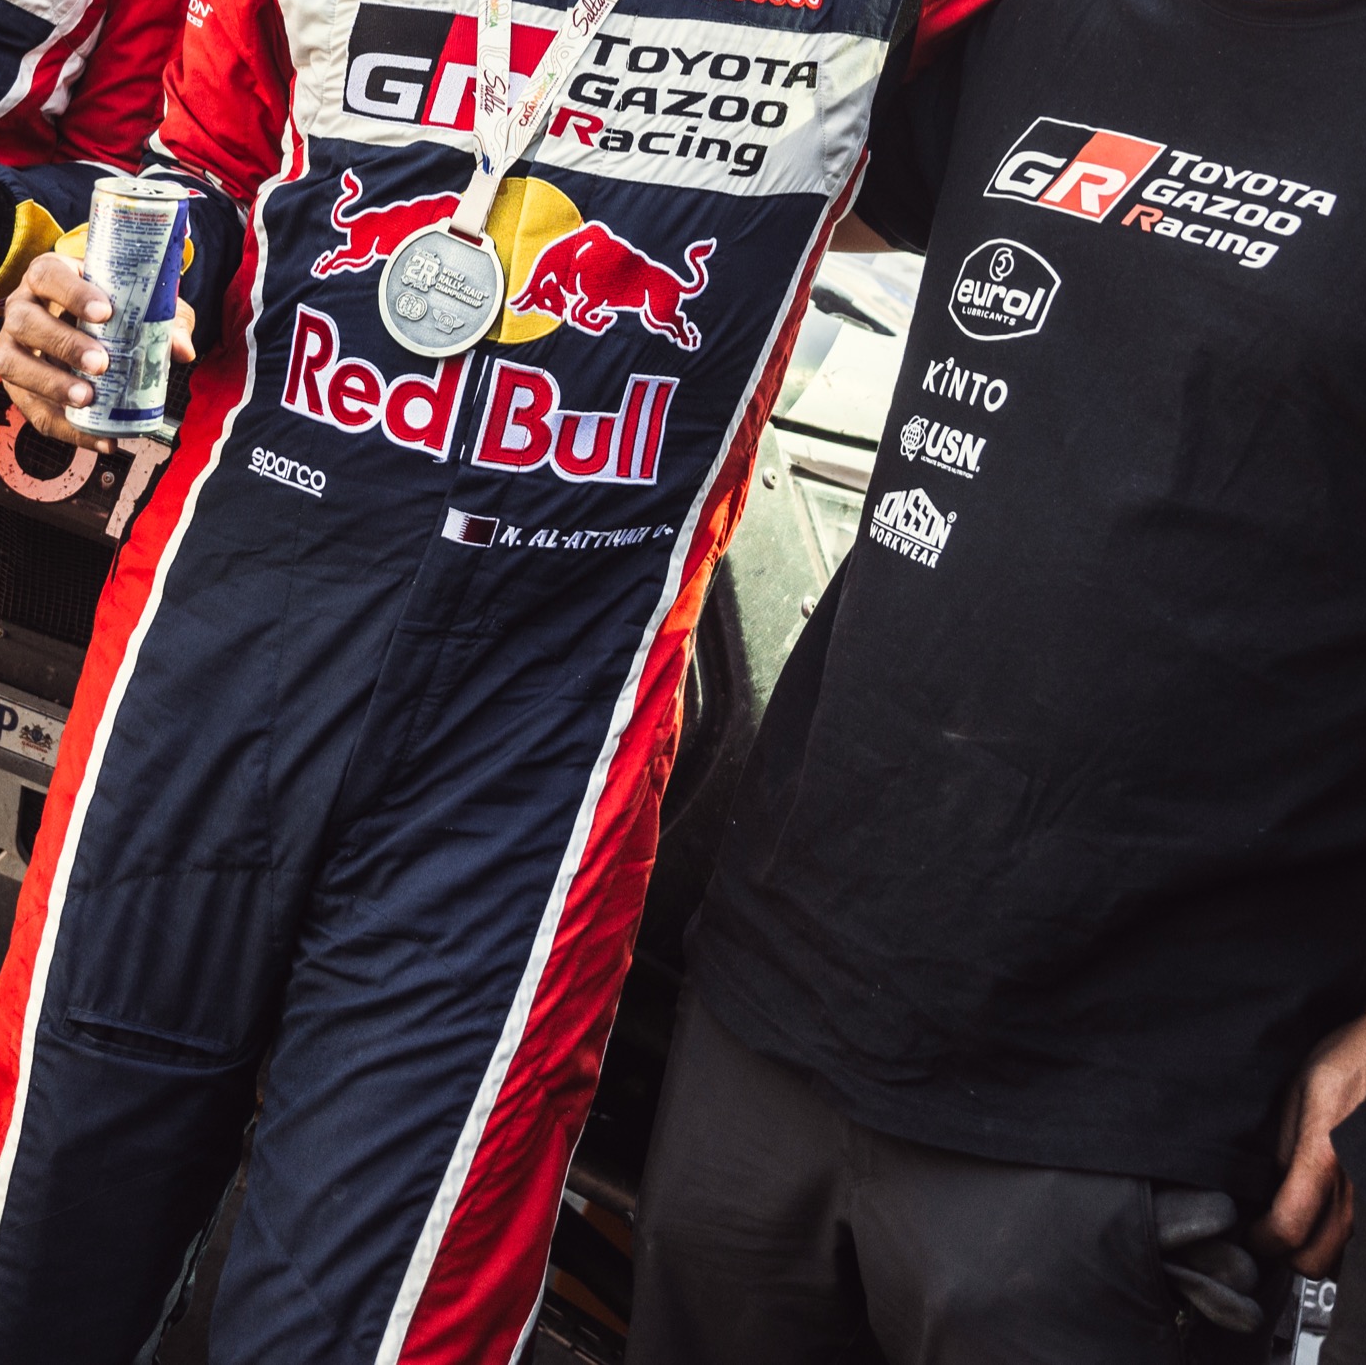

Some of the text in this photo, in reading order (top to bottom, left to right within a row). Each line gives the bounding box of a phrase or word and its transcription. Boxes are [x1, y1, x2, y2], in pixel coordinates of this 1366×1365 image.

[592, 33, 819, 90] TOYOTA
[568, 72, 788, 128] GAZOO
[548, 106, 769, 178] Racing
[993, 150, 1127, 214] GR
[1140, 178, 1303, 237] GAZOO
[1168, 149, 1337, 217] TOYOTA
[1121, 203, 1280, 270] Racing
[434, 283, 483, 309] CHAMPIONSHIP
[437, 273, 484, 301] RALLY-RAID
[442, 267, 466, 282] WORLD
[956, 276, 1047, 321] eurol
[960, 305, 1017, 327] LUBRICANTS
[281, 304, 474, 462] Red
[471, 357, 680, 485] Bull
[247, 445, 327, 497] sparco
[499, 524, 523, 547] N.
[528, 526, 652, 549] AL-ATTIYAH
[869, 522, 940, 569] WORKWEAR
